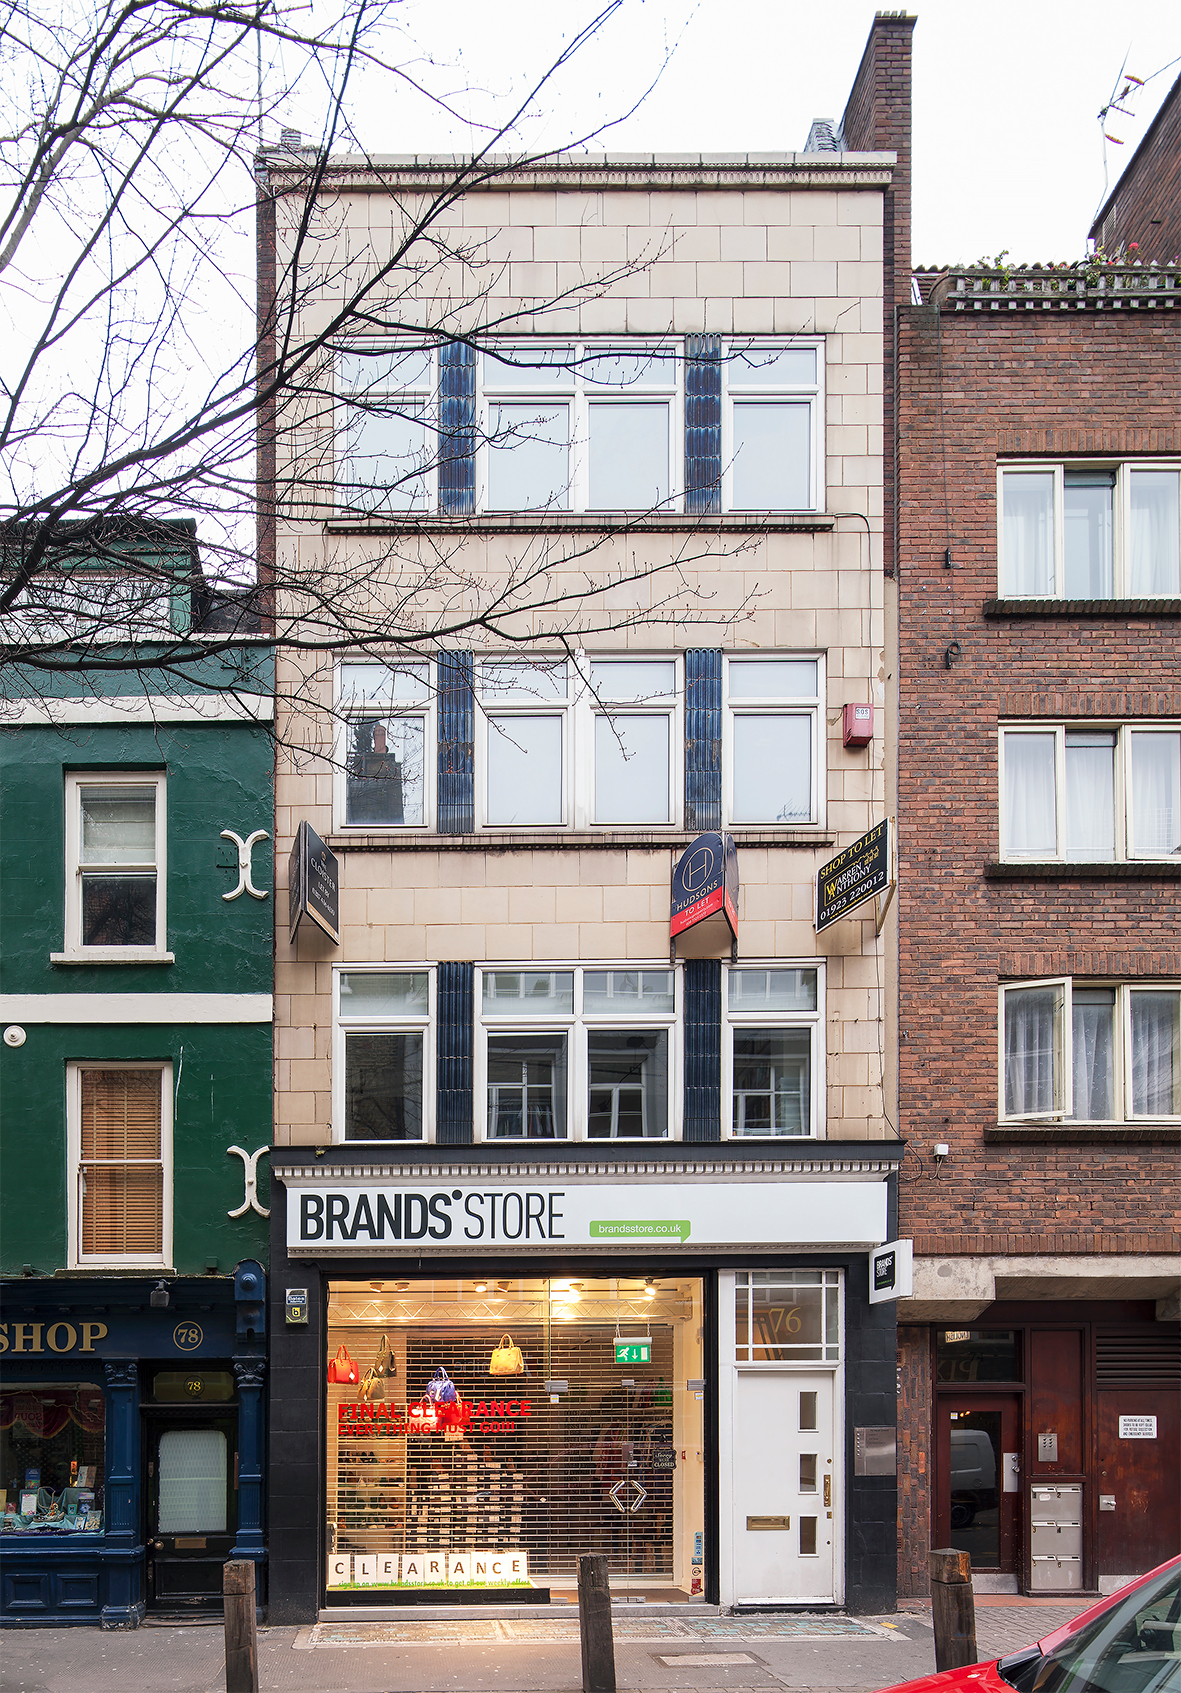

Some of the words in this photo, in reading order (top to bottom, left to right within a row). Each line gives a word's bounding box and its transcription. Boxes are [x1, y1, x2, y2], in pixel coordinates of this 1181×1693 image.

[820, 854, 846, 880] SHOP
[848, 840, 863, 859] TO
[864, 824, 884, 847] LET
[688, 851, 707, 888] H
[826, 862, 862, 895] WARREN
[828, 863, 872, 900] ANTHONY
[676, 879, 718, 912] HUDSONS
[684, 905, 695, 918] TO
[697, 896, 710, 911] LET
[820, 896, 847, 921] 01923
[849, 871, 885, 902] 220012
[464, 1192, 565, 1239] STORE
[598, 1223, 682, 1235] brandsstore.co.uk
[769, 1307, 802, 1333] 76
[177, 1328, 199, 1344] 78
[187, 1380, 201, 1392] 78
[338, 1403, 402, 1420] FINAL
[408, 1400, 532, 1418] CLEARANCE
[338, 1422, 431, 1435] EVERYTHING
[436, 1422, 475, 1434] MUST
[480, 1421, 516, 1434] GO!!!
[335, 1560, 520, 1575] CLEARANCE
[338, 1581, 351, 1589] sign
[372, 1579, 444, 1587] www.brandsstore.co.uk
[455, 1580, 465, 1588] get
[488, 1578, 510, 1587] weekly
[511, 1578, 530, 1586] offers
